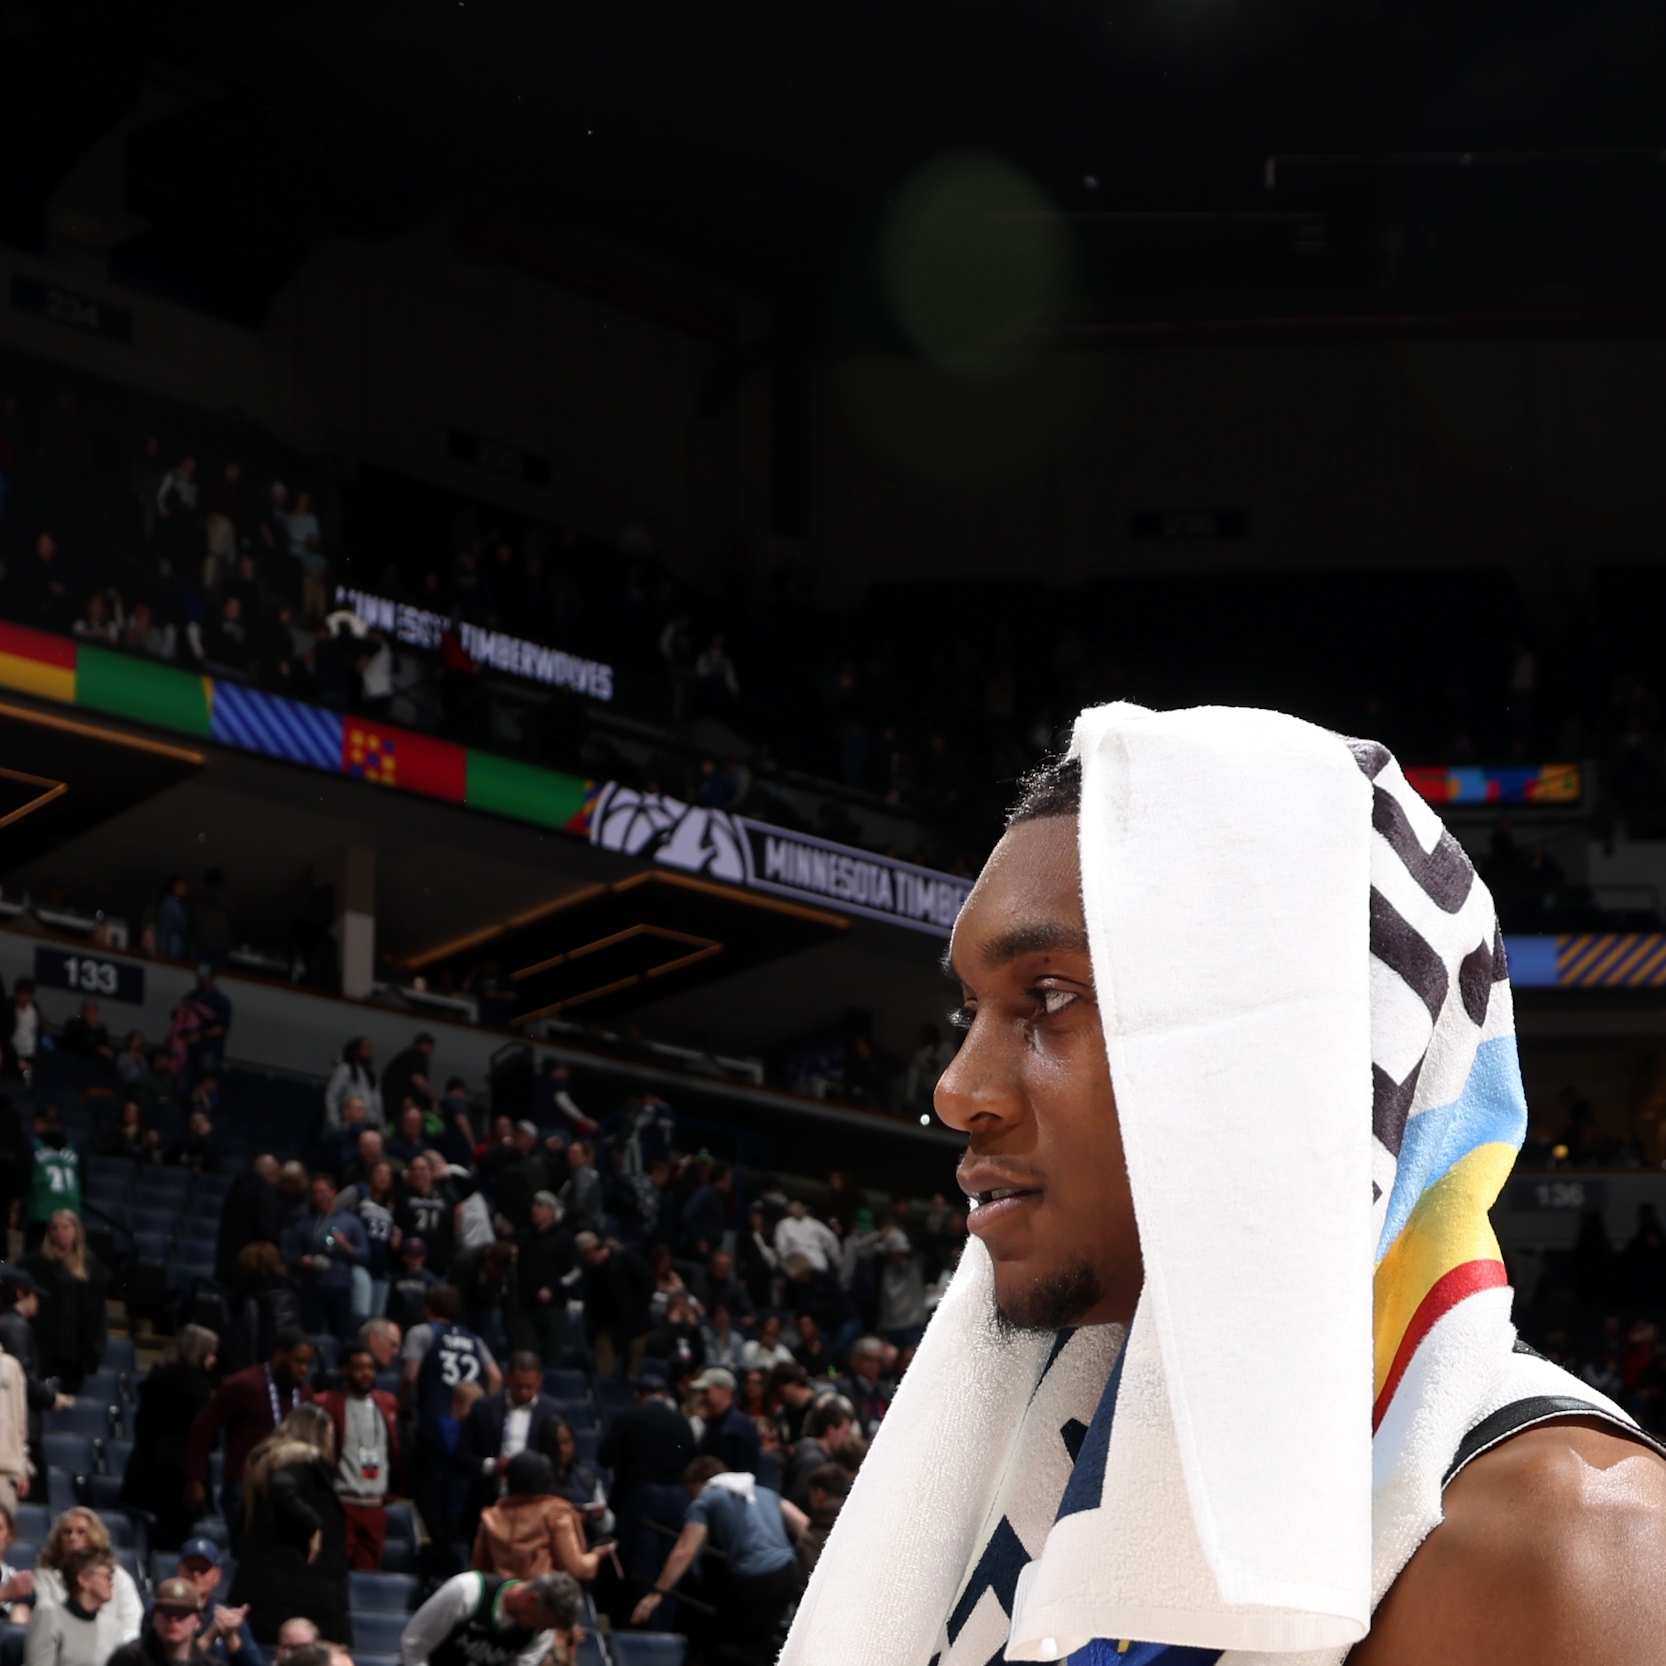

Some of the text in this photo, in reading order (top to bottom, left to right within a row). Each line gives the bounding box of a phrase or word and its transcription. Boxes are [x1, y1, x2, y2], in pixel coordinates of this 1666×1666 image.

[764, 835, 895, 911] MINNESOTA
[64, 956, 119, 996] 133
[439, 1350, 481, 1387] 32
